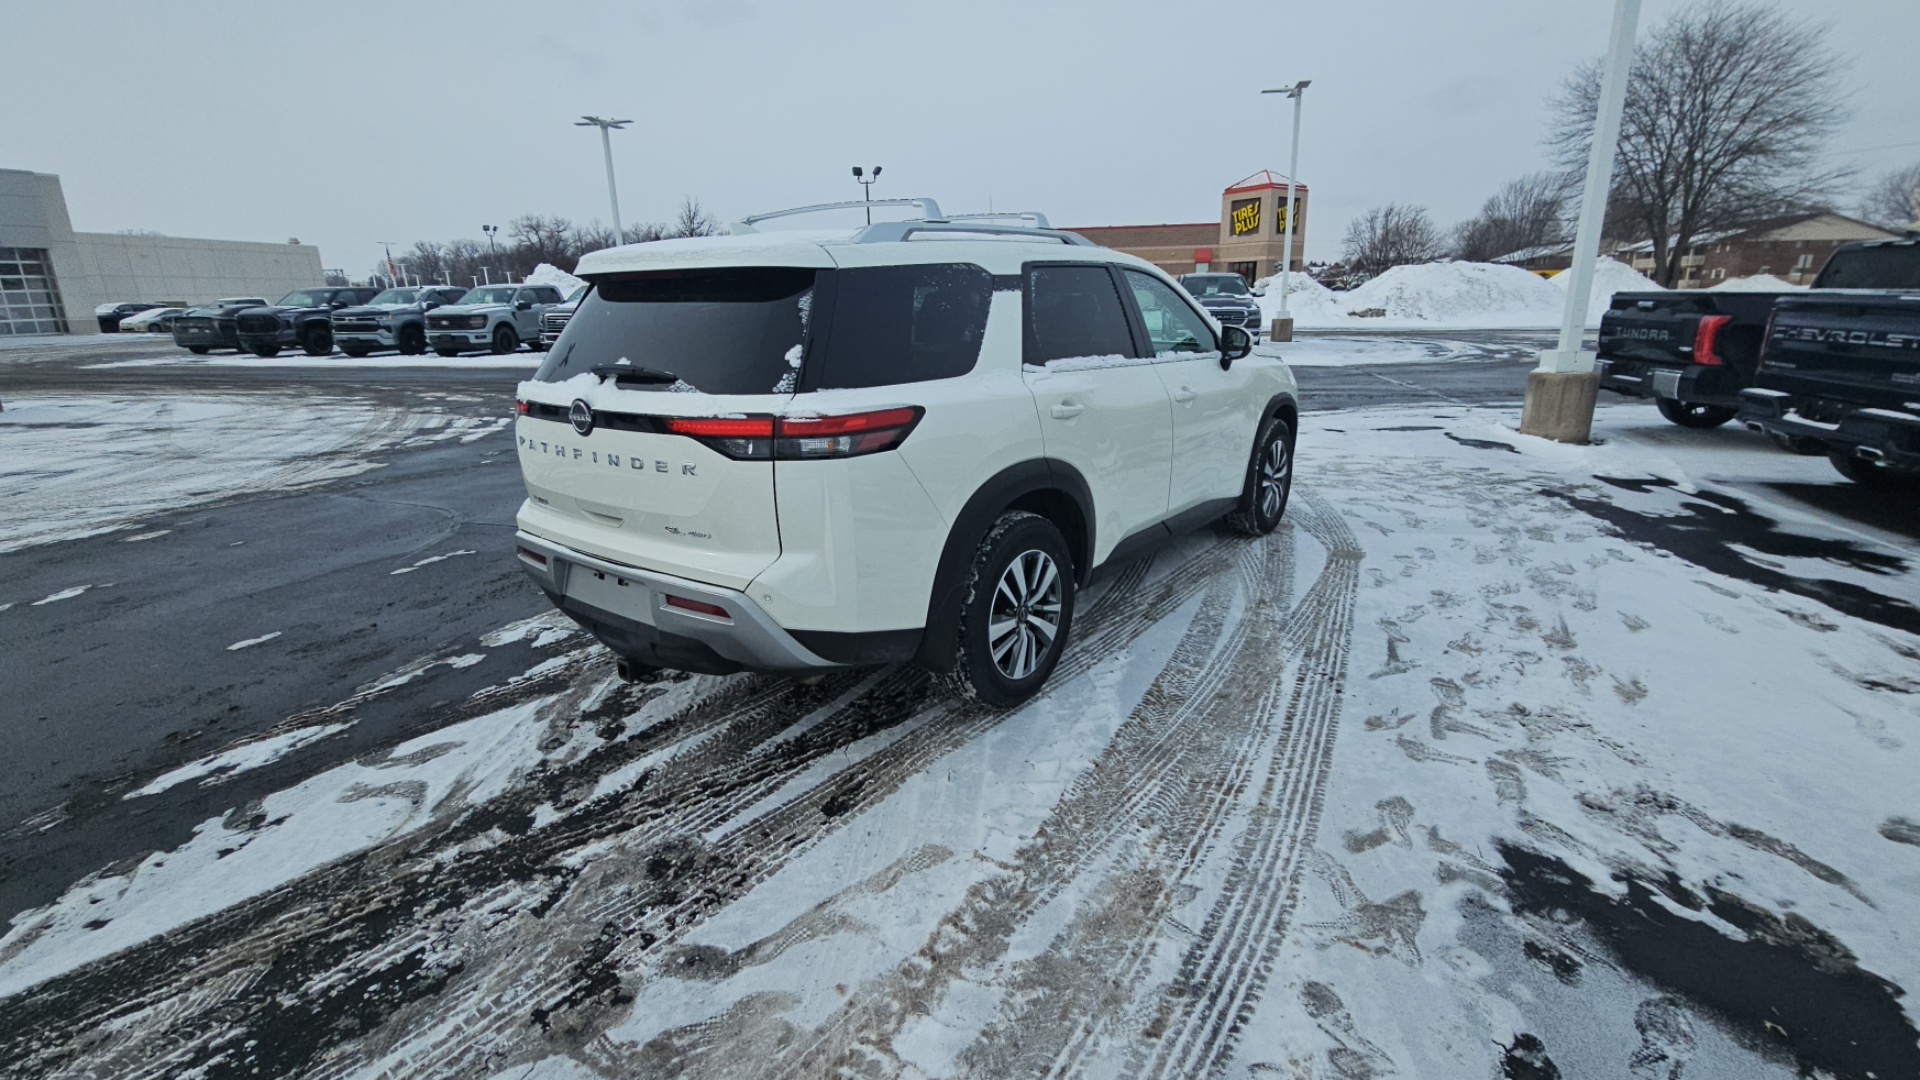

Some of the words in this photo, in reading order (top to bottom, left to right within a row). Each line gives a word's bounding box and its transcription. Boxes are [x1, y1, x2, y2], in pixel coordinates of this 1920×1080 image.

[1232, 201, 1260, 223] TIRES
[1277, 201, 1299, 220] TIS
[1235, 214, 1260, 235] PLUS
[1279, 214, 1299, 233] PS
[1615, 326, 1669, 341] TUNDRA
[519, 436, 698, 476] PATHFINDER
